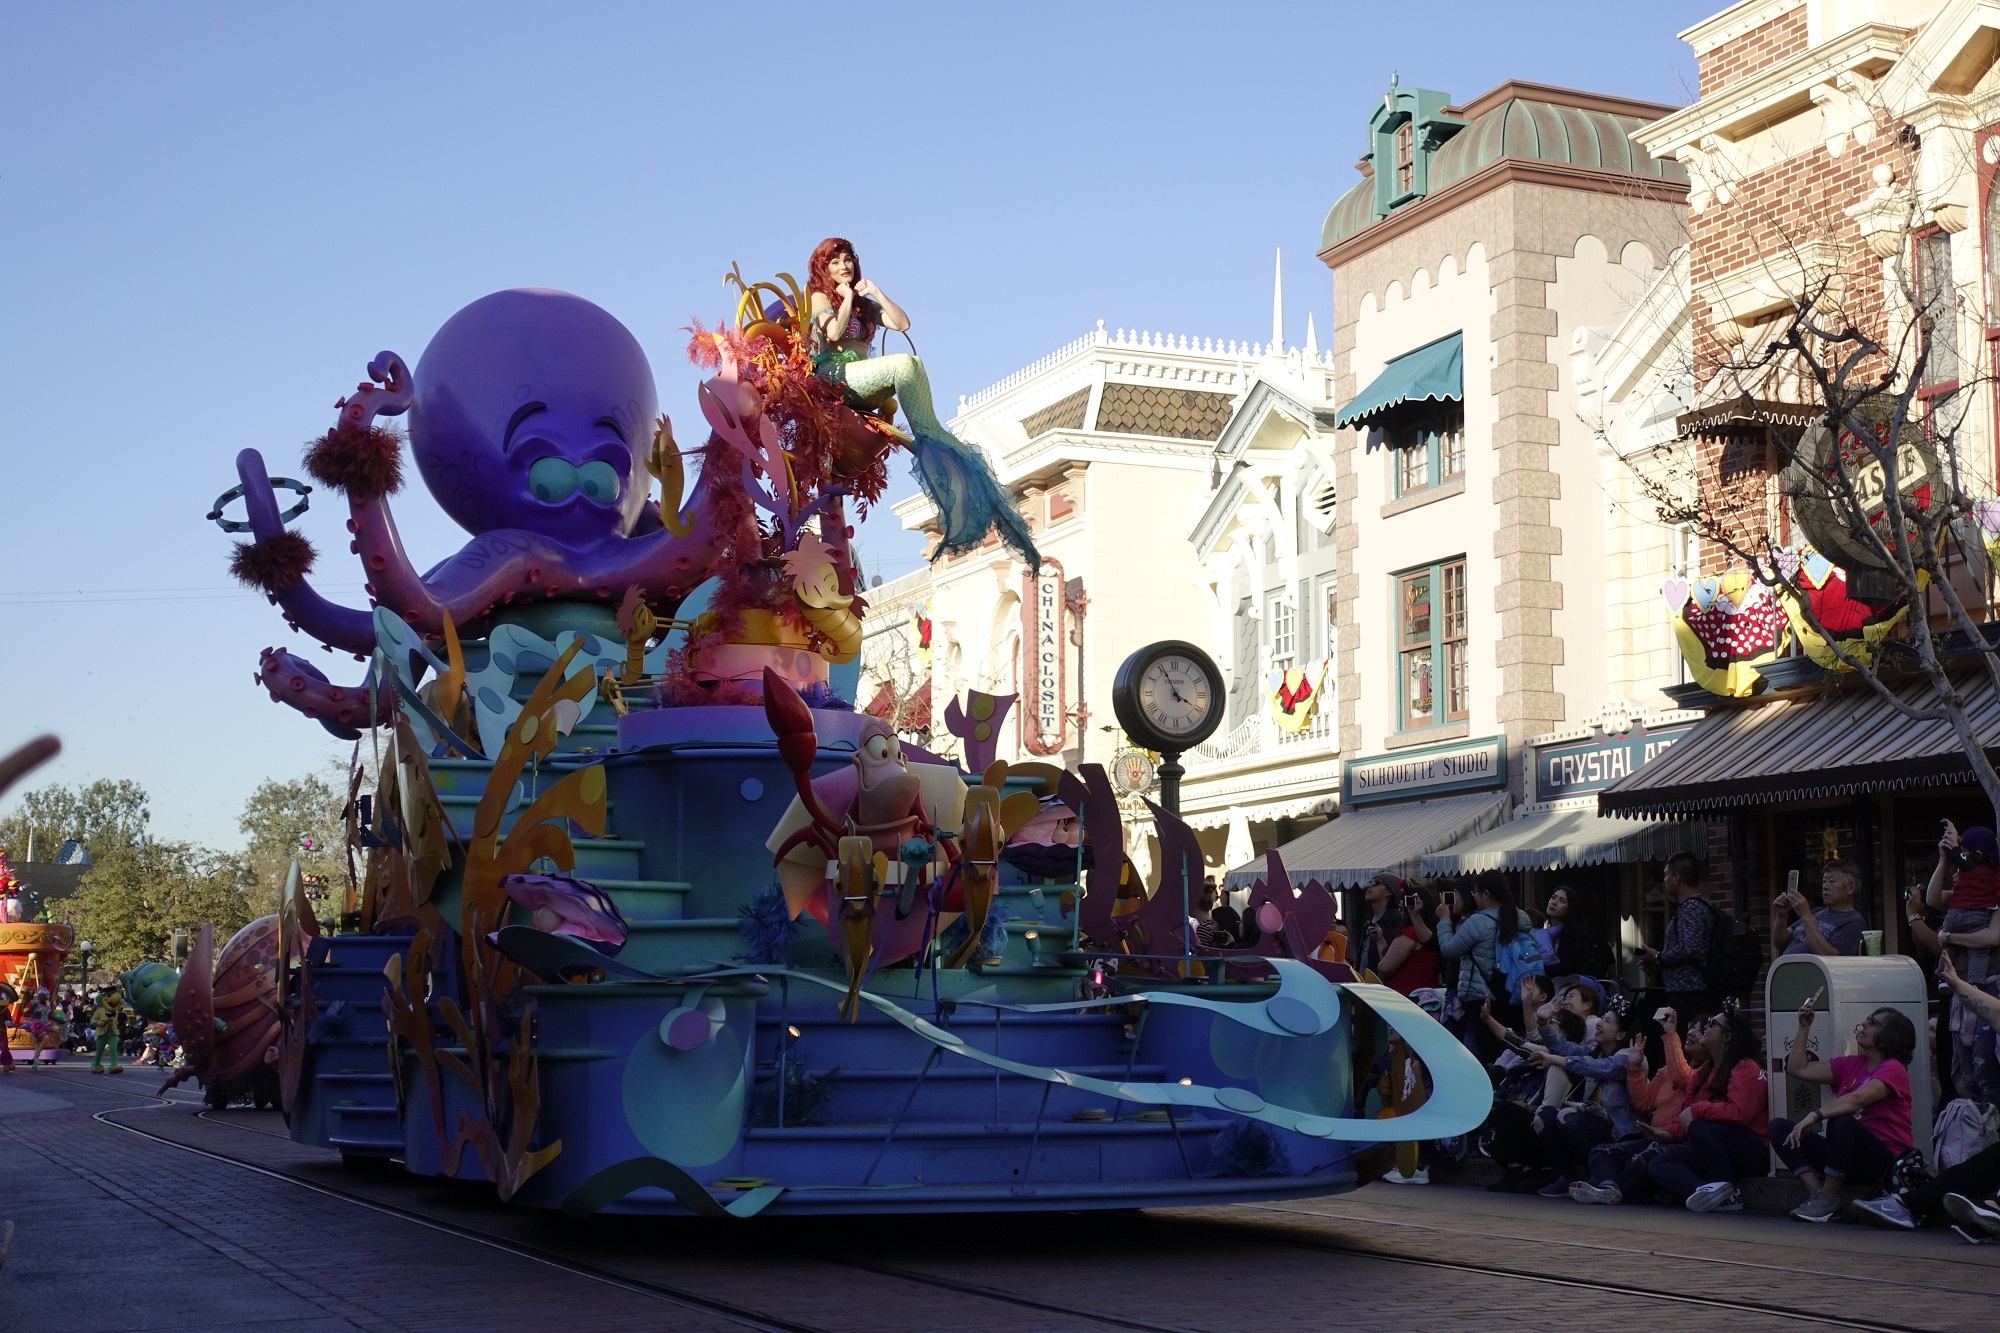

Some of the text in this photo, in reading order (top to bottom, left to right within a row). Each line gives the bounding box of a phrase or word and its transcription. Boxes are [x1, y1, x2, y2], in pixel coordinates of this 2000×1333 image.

[1851, 446, 1914, 505] ASLE
[1041, 583, 1055, 728] CHINA CLOSET
[1170, 661, 1179, 671] XII
[1197, 691, 1206, 699] III
[1359, 751, 1489, 789] SILHOUETTE STUDIO
[1549, 746, 1636, 787] CRYSTAL
